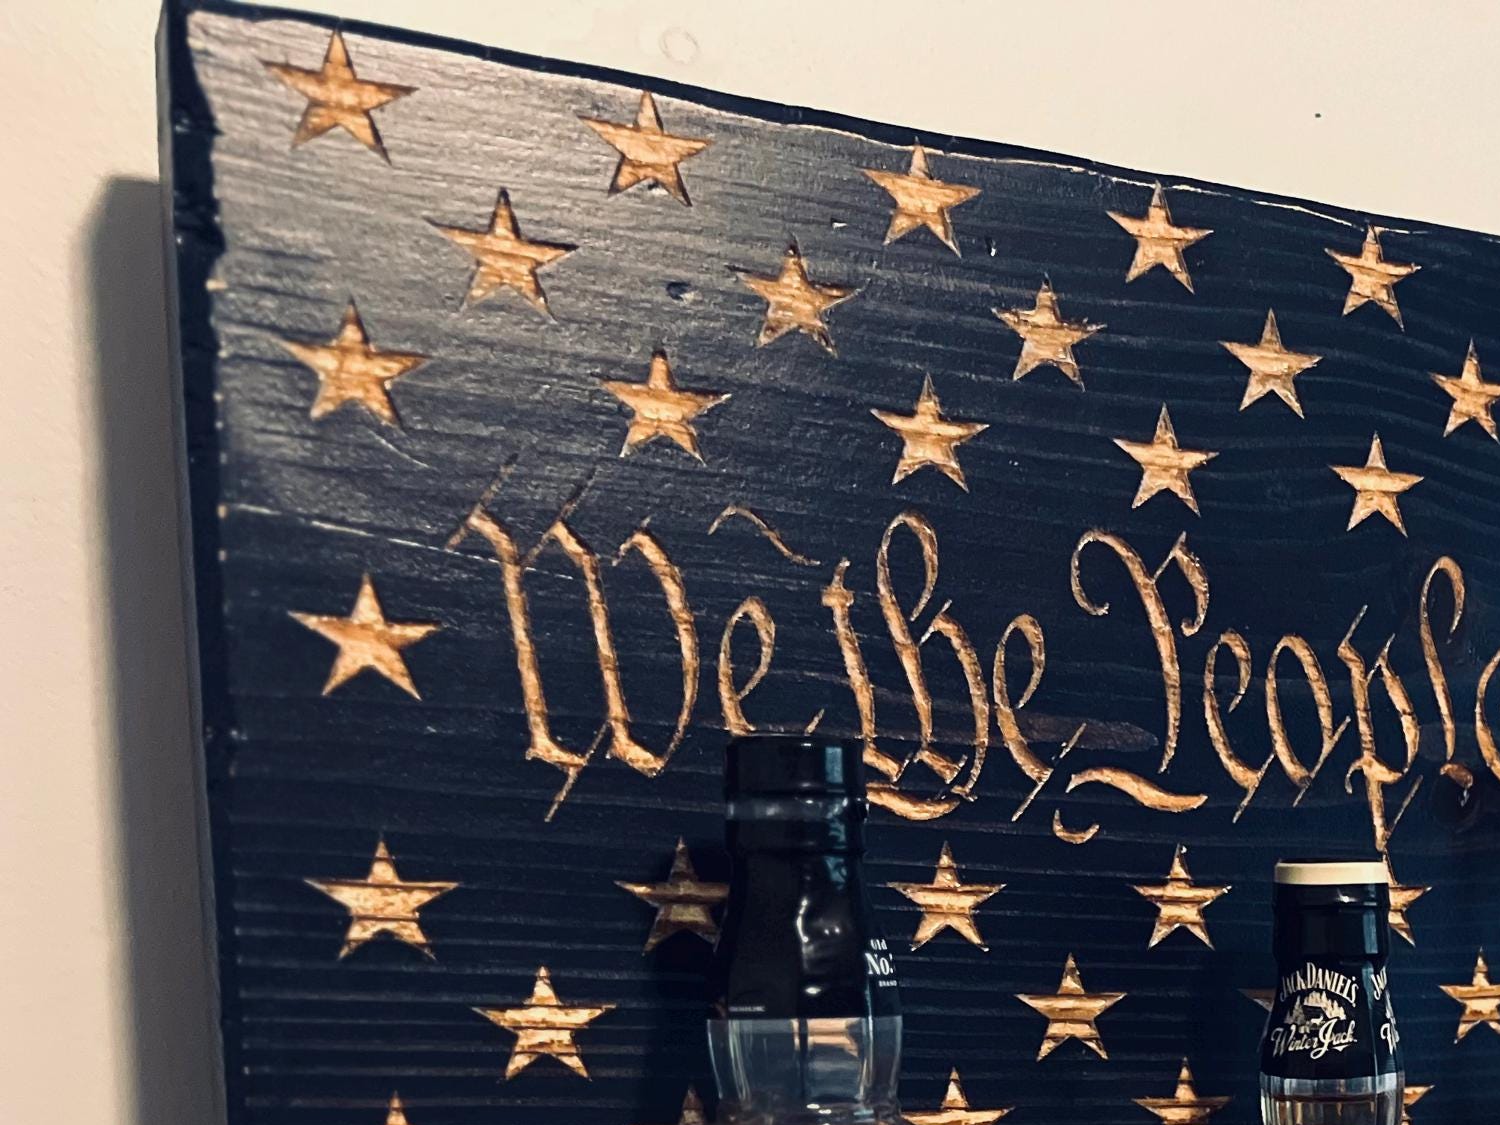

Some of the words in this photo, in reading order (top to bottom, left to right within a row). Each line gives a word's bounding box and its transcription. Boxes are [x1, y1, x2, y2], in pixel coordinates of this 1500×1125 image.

[445, 455, 825, 822] We
[820, 508, 1088, 822] the
[864, 952, 897, 976] No.
[1280, 968, 1306, 1003] JACK
[1305, 962, 1359, 1007] DANIEL'S
[1270, 1023, 1320, 1057] Winter
[1310, 1018, 1357, 1060] Jack
